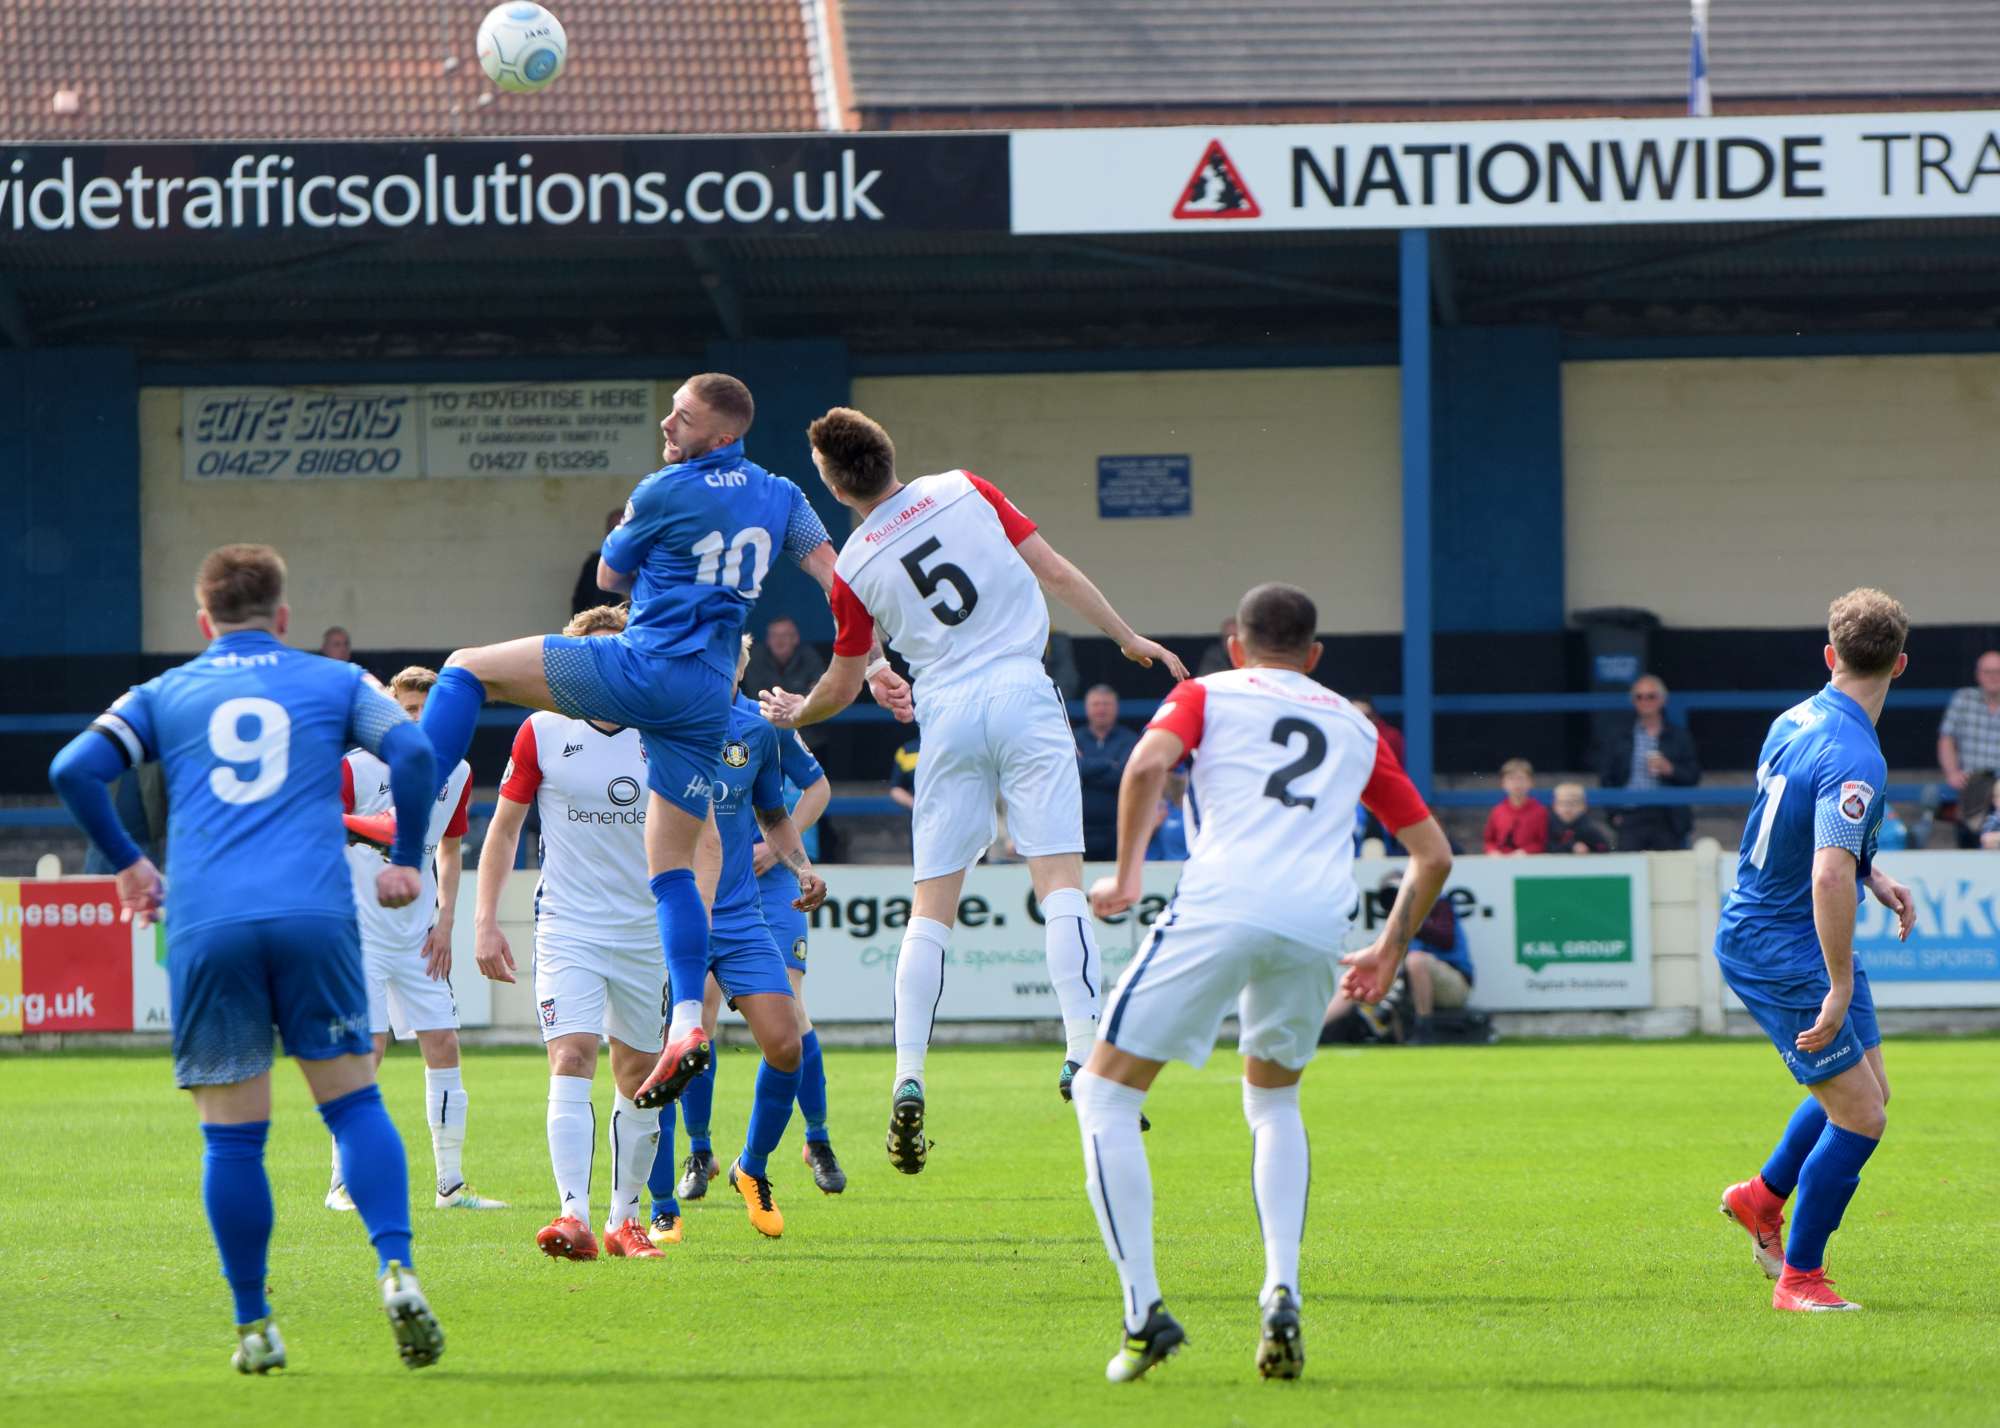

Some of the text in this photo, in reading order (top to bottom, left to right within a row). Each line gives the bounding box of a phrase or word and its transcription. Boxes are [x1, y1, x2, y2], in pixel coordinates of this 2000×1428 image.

[1292, 136, 1825, 208] NATIONWIDE
[196, 393, 408, 443] ELITE SIGNS
[430, 387, 648, 411] TO ADVERTISE HERE
[431, 415, 479, 429] CONTACT
[197, 447, 402, 476] 01427 811800
[468, 449, 610, 471] 01427 613295
[869, 495, 935, 543] BUILDBASE
[691, 526, 772, 599] 10
[899, 534, 979, 627] 5
[207, 696, 292, 806] 9
[1263, 716, 1327, 812] 2
[1562, 940, 1628, 957] GROUP
[0, 986, 95, 1025] org.uk
[1815, 1045, 1851, 1068] JARTAZI
